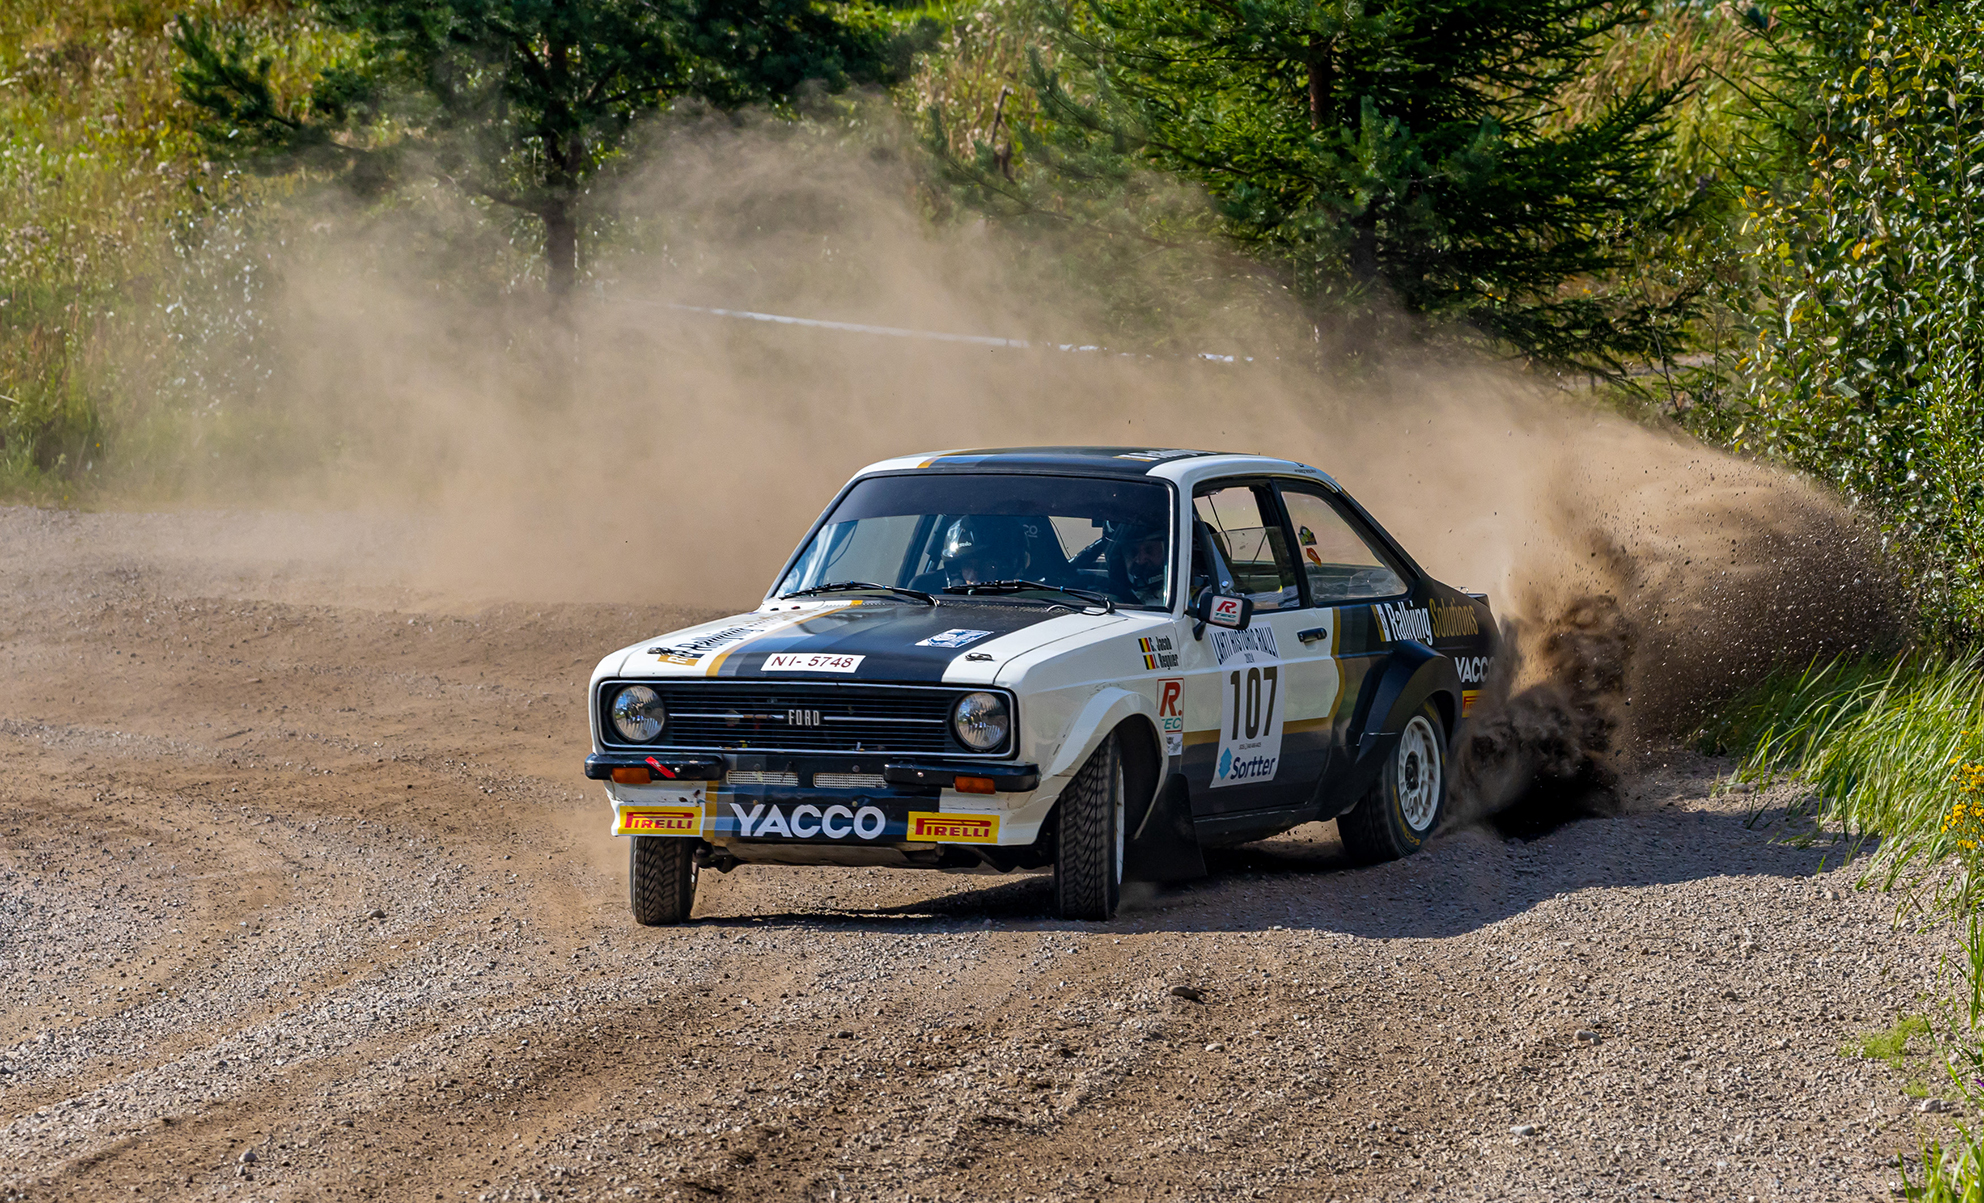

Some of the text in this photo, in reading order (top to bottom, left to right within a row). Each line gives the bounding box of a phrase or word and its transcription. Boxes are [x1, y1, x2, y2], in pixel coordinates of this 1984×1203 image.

[1383, 599, 1433, 646] Rallying
[1428, 597, 1479, 638] Solutions
[1254, 626, 1279, 659] RALLY
[807, 656, 854, 668] 5748
[1230, 666, 1277, 740] 107
[788, 709, 820, 726] FORD
[1230, 756, 1276, 780] Sortter
[624, 811, 694, 829] PIRELLI
[729, 802, 887, 840] YACCO
[915, 817, 992, 838] PIRELLI
